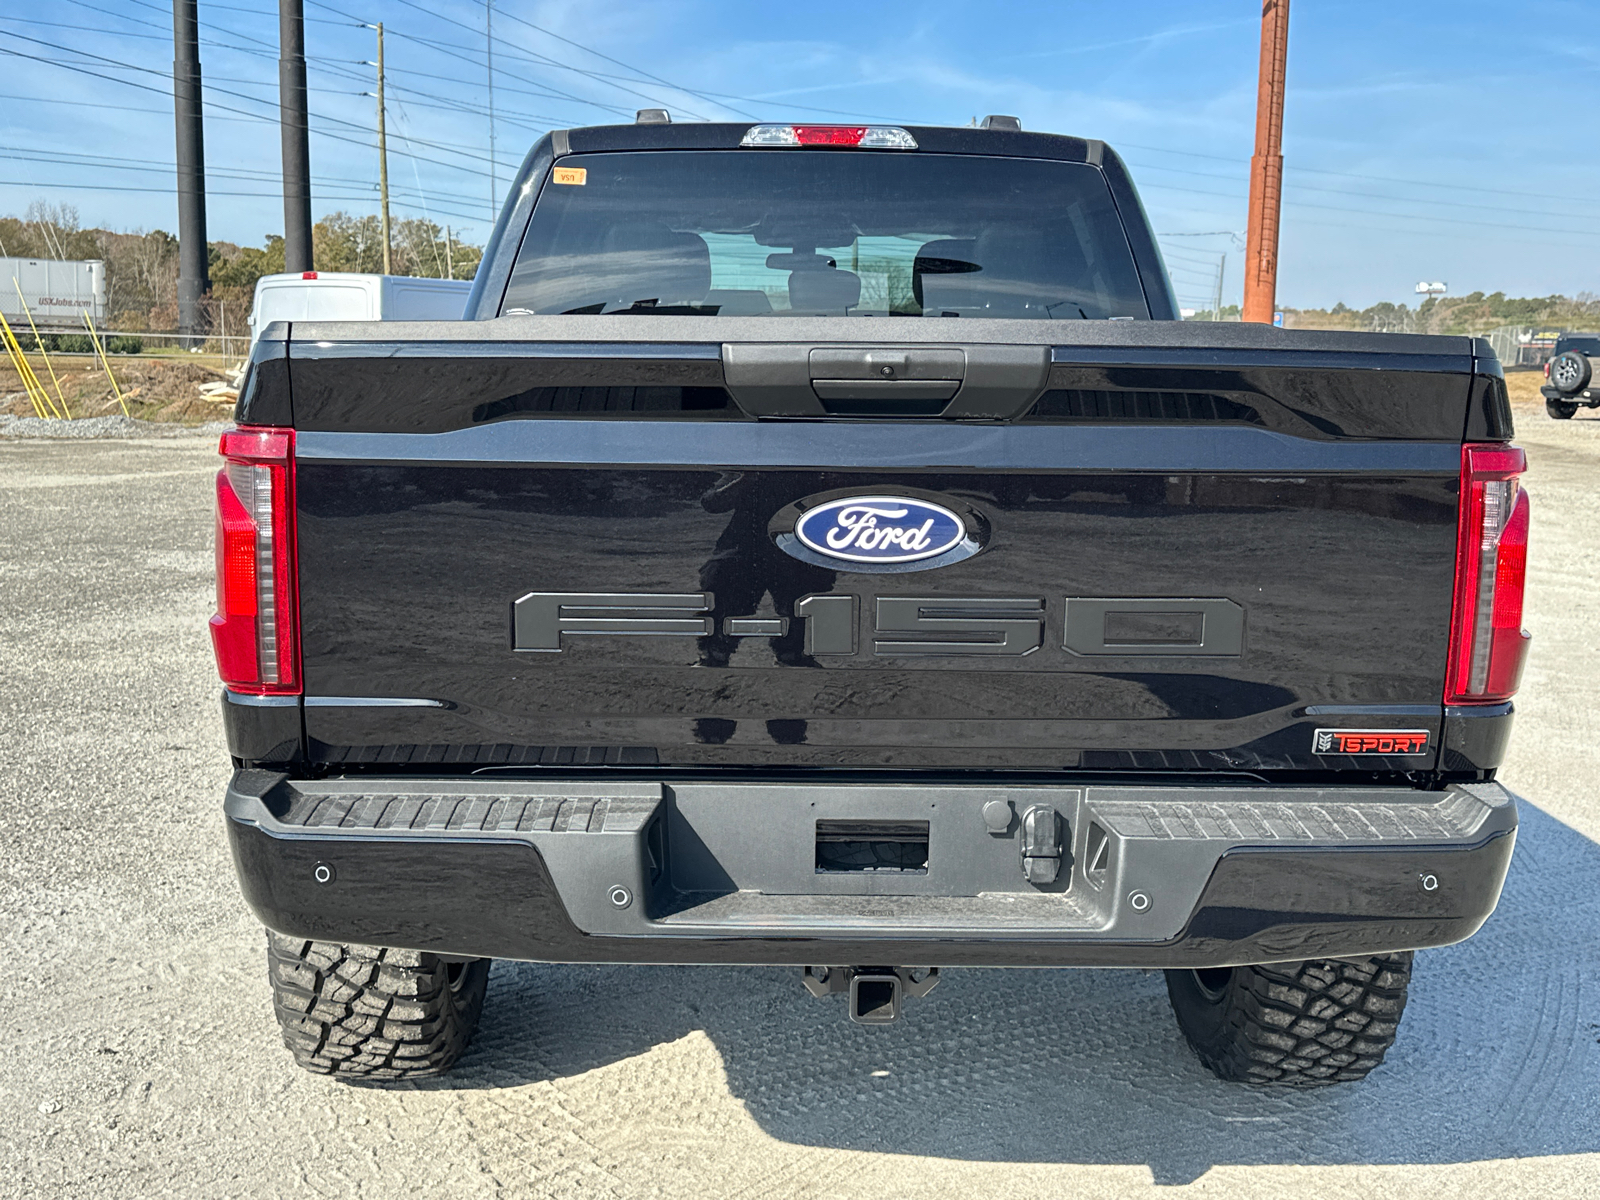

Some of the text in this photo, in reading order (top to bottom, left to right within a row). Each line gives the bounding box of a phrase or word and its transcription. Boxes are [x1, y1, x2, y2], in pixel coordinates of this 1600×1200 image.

[38, 297, 92, 308] USXJobs.com
[826, 506, 935, 550] Ford
[511, 591, 1244, 658] F-150
